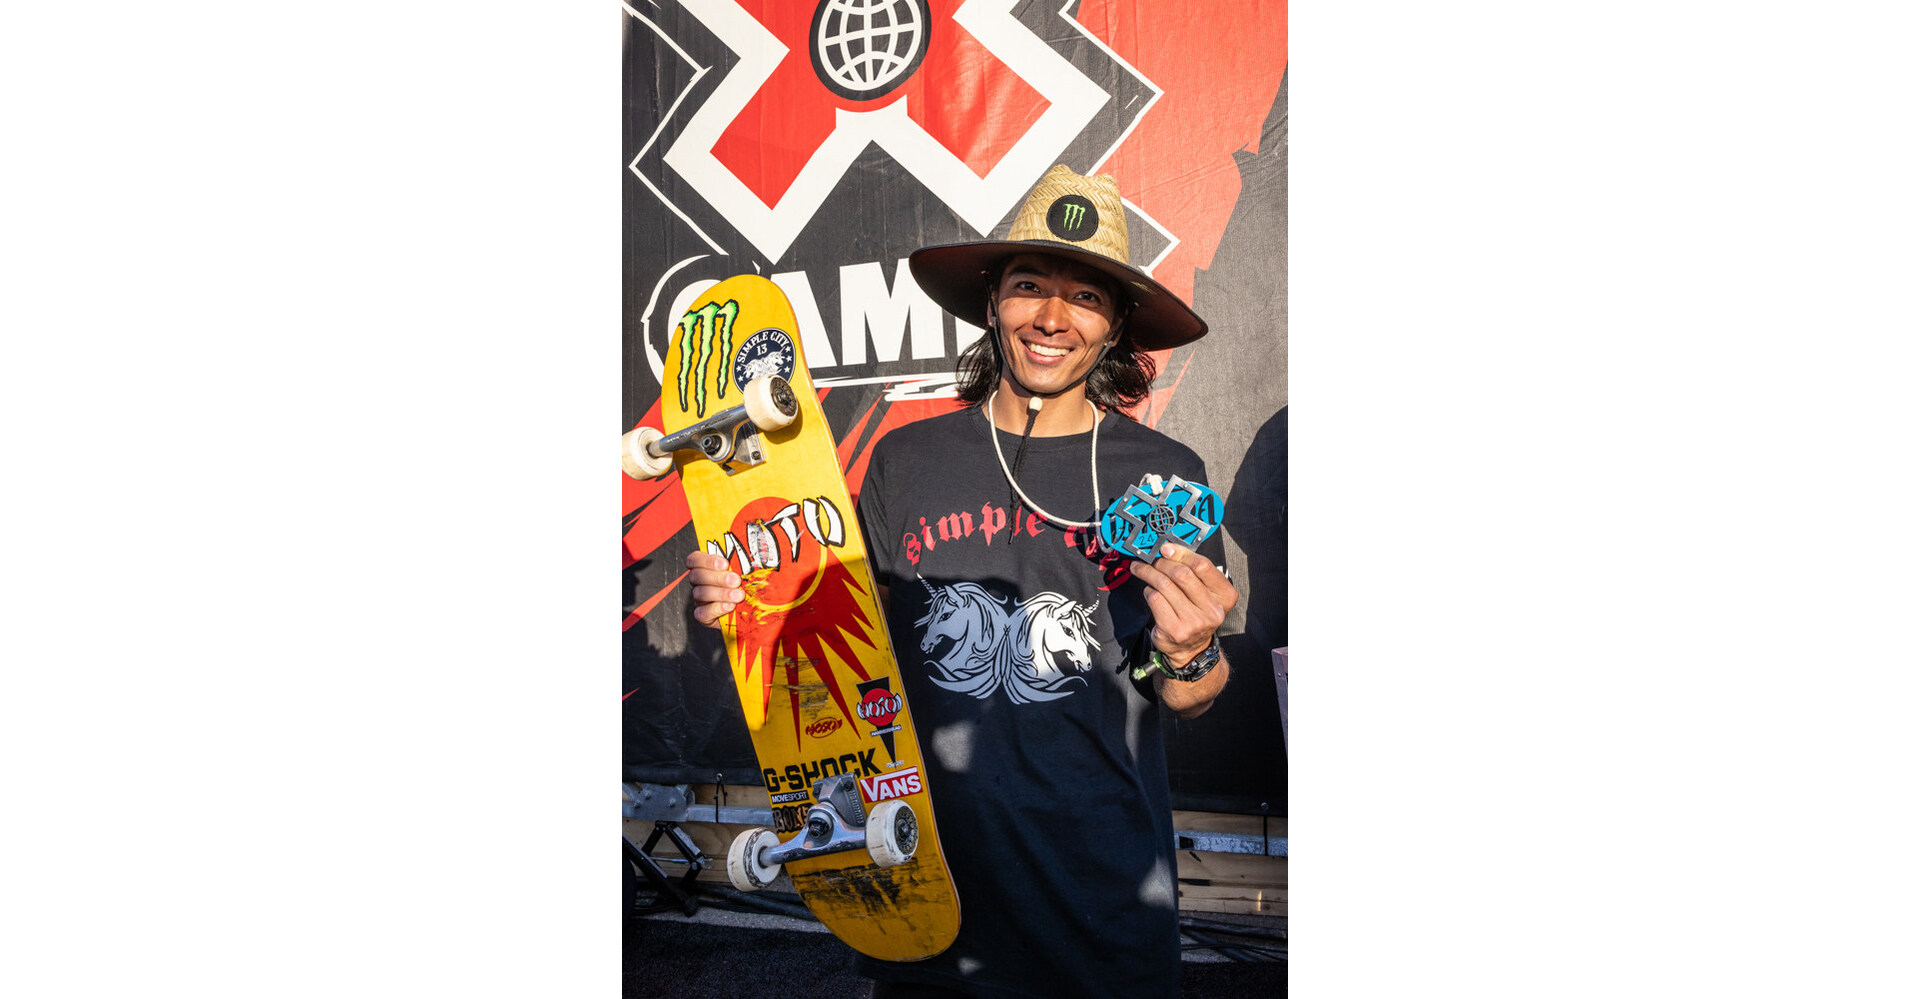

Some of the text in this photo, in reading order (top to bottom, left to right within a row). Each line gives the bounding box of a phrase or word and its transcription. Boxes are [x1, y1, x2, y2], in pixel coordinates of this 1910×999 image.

[737, 331, 790, 364] SIMPLE CITY
[756, 343, 768, 356] 13
[903, 502, 1048, 566] simple
[771, 790, 808, 804] MOVESPORT
[860, 766, 922, 802] VANS
